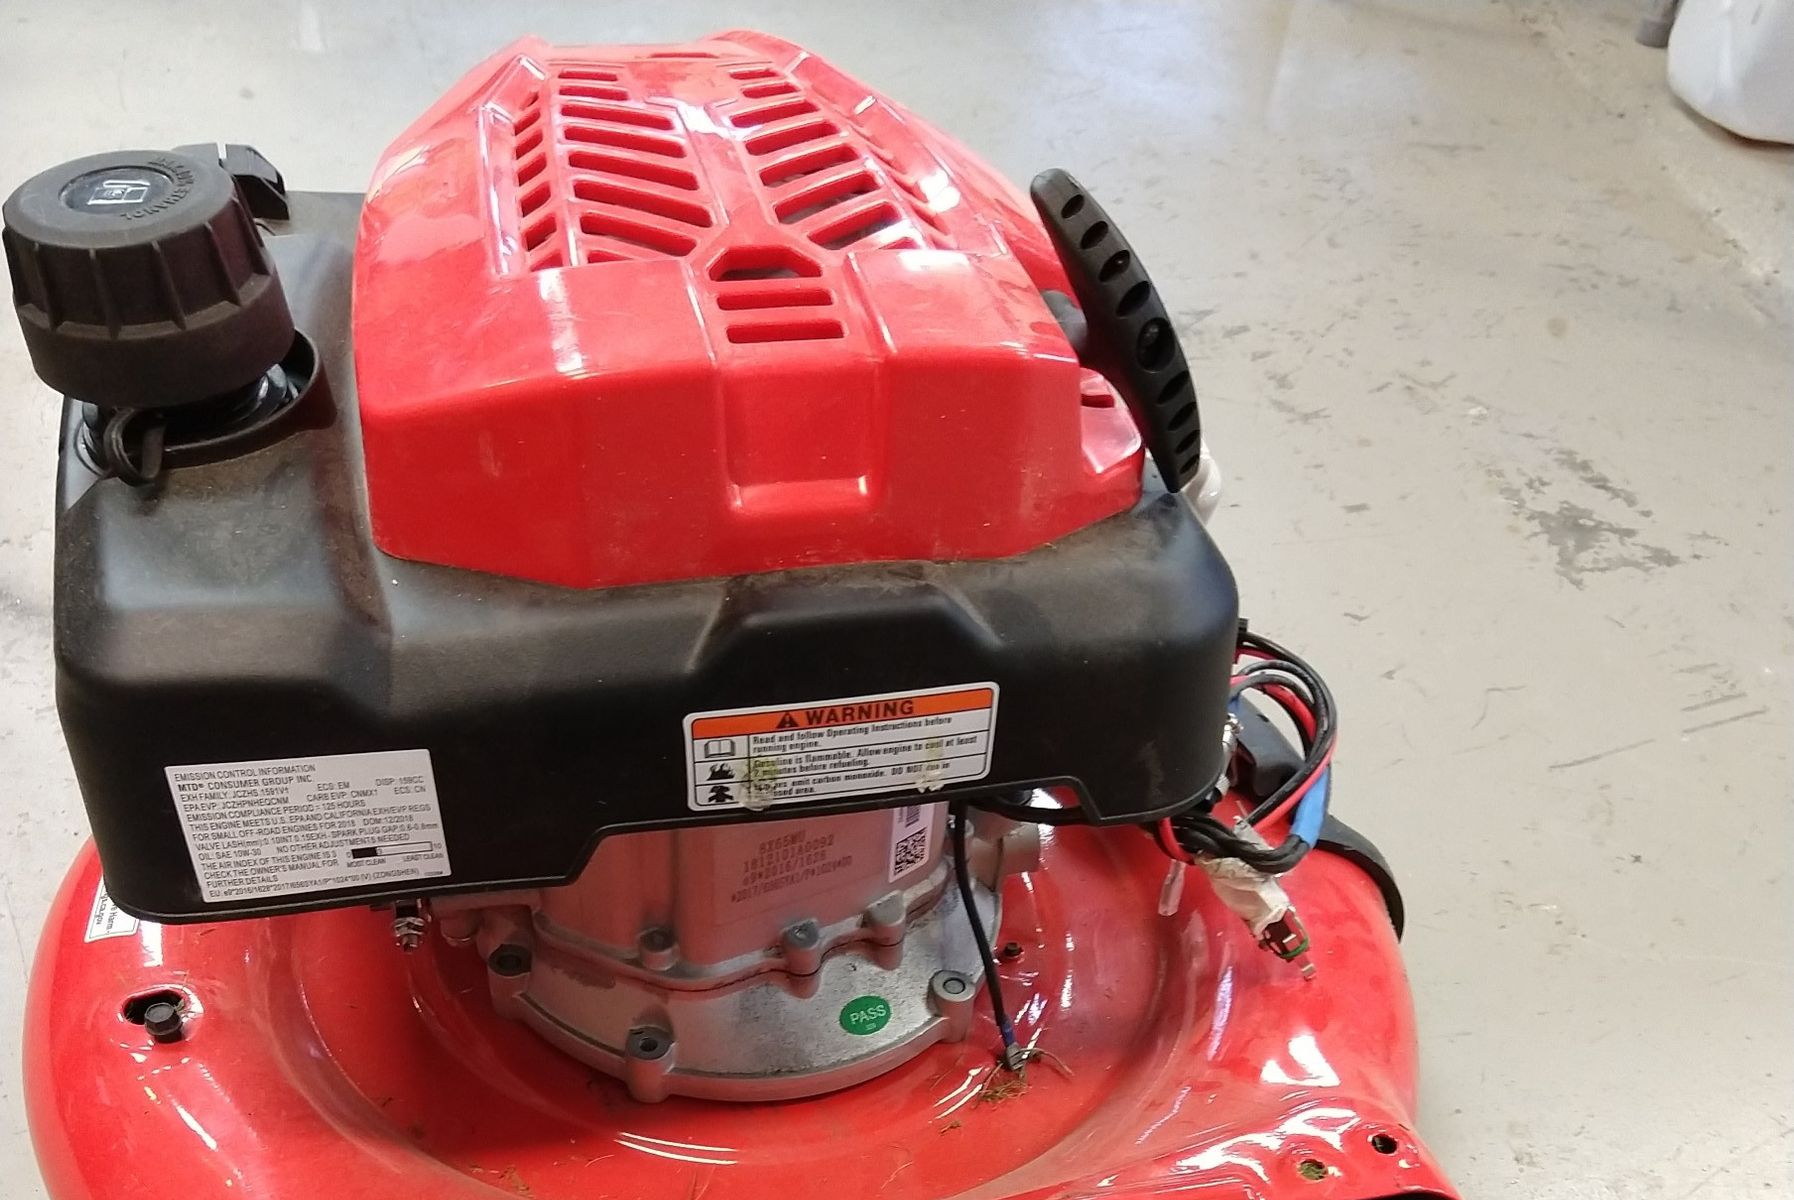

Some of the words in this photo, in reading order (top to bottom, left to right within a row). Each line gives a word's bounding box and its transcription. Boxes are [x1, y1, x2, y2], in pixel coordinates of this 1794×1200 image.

[806, 700, 913, 725] WARNING
[753, 734, 775, 744] Read
[782, 732, 793, 741] and
[797, 729, 824, 739] follow
[826, 725, 868, 738] Operating
[872, 719, 921, 731] Instructions
[925, 716, 952, 725] before
[753, 743, 786, 754] running
[789, 740, 821, 751] engine.
[795, 755, 802, 763] is
[805, 750, 851, 762] flammable.
[857, 747, 880, 756] Allow
[883, 745, 911, 755] engine
[956, 736, 976, 744] least
[174, 771, 215, 781] EMISSION
[216, 768, 257, 778] CONTROL
[258, 764, 315, 775] INFORMATION
[800, 762, 826, 771] before
[829, 758, 868, 769] refueling.
[207, 779, 259, 789] CONSUMER
[261, 776, 294, 785] GROUP
[337, 781, 350, 789] EM
[813, 775, 840, 783] carbon
[306, 793, 329, 801] CARB
[186, 812, 226, 821] EMISSION
[227, 807, 282, 818] COMPLIANCE
[283, 804, 314, 813] PERIOD
[336, 800, 366, 808] HOURS
[189, 823, 208, 831] THIS
[209, 820, 241, 829] ENGINE
[242, 818, 271, 826] MEETS
[304, 813, 322, 821] AND
[323, 809, 371, 819] CALIFORNIA
[192, 833, 210, 841] FOR
[211, 831, 238, 839] SMALL
[238, 827, 281, 837] OFF-ROAD
[282, 824, 318, 833] ENGINES
[195, 842, 220, 850] VALVE
[330, 829, 357, 837] SPARK
[359, 826, 380, 835] PLUG
[233, 848, 261, 856] 10W-30
[289, 842, 319, 851] OTHER
[318, 837, 376, 848] ADJUSTMENTS
[377, 833, 410, 842] NEEDED
[233, 859, 258, 867] INDEX
[291, 852, 321, 861] ENGINE
[203, 870, 234, 879] CHECK
[250, 865, 287, 874] OWNER'S
[288, 861, 321, 871] MANUAL
[206, 878, 245, 888] FURTHER
[245, 875, 278, 884] DETAILS
[850, 1004, 887, 1025] PASS
